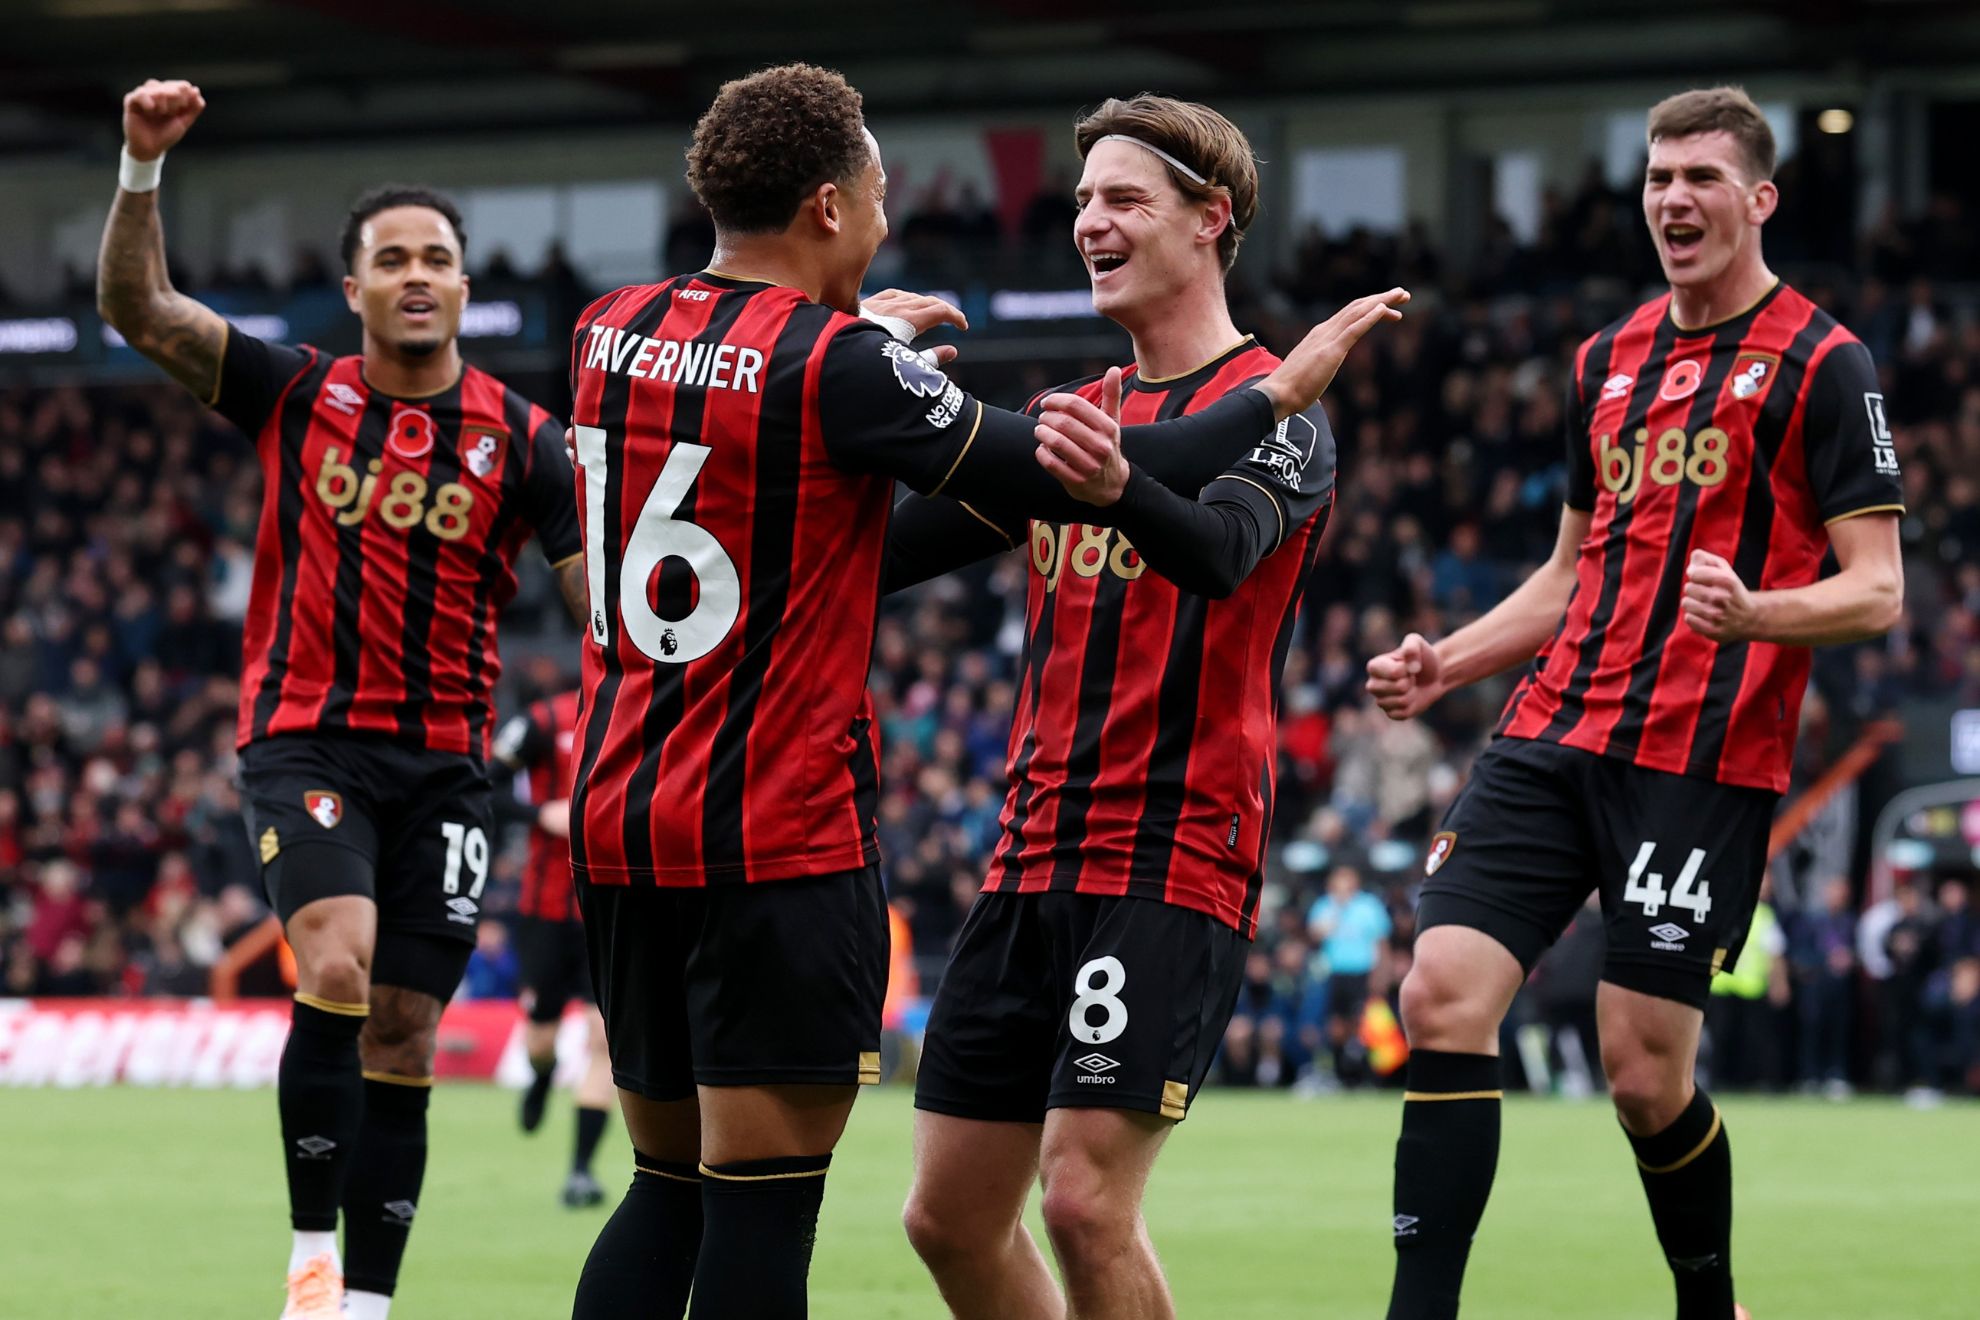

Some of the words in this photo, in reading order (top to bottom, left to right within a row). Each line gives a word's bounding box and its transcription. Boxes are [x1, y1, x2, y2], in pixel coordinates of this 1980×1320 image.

[678, 289, 711, 301] AFCB
[584, 323, 764, 394] TAVERNIER
[925, 404, 946, 425] No
[316, 445, 475, 541] bj88
[1249, 447, 1302, 493] LEOS
[1601, 427, 1730, 505] bj88
[574, 423, 741, 664] 16
[441, 821, 489, 899] 19
[1623, 841, 1713, 924] 44
[1068, 955, 1129, 1045] 8
[1076, 1074, 1116, 1085] umbro
